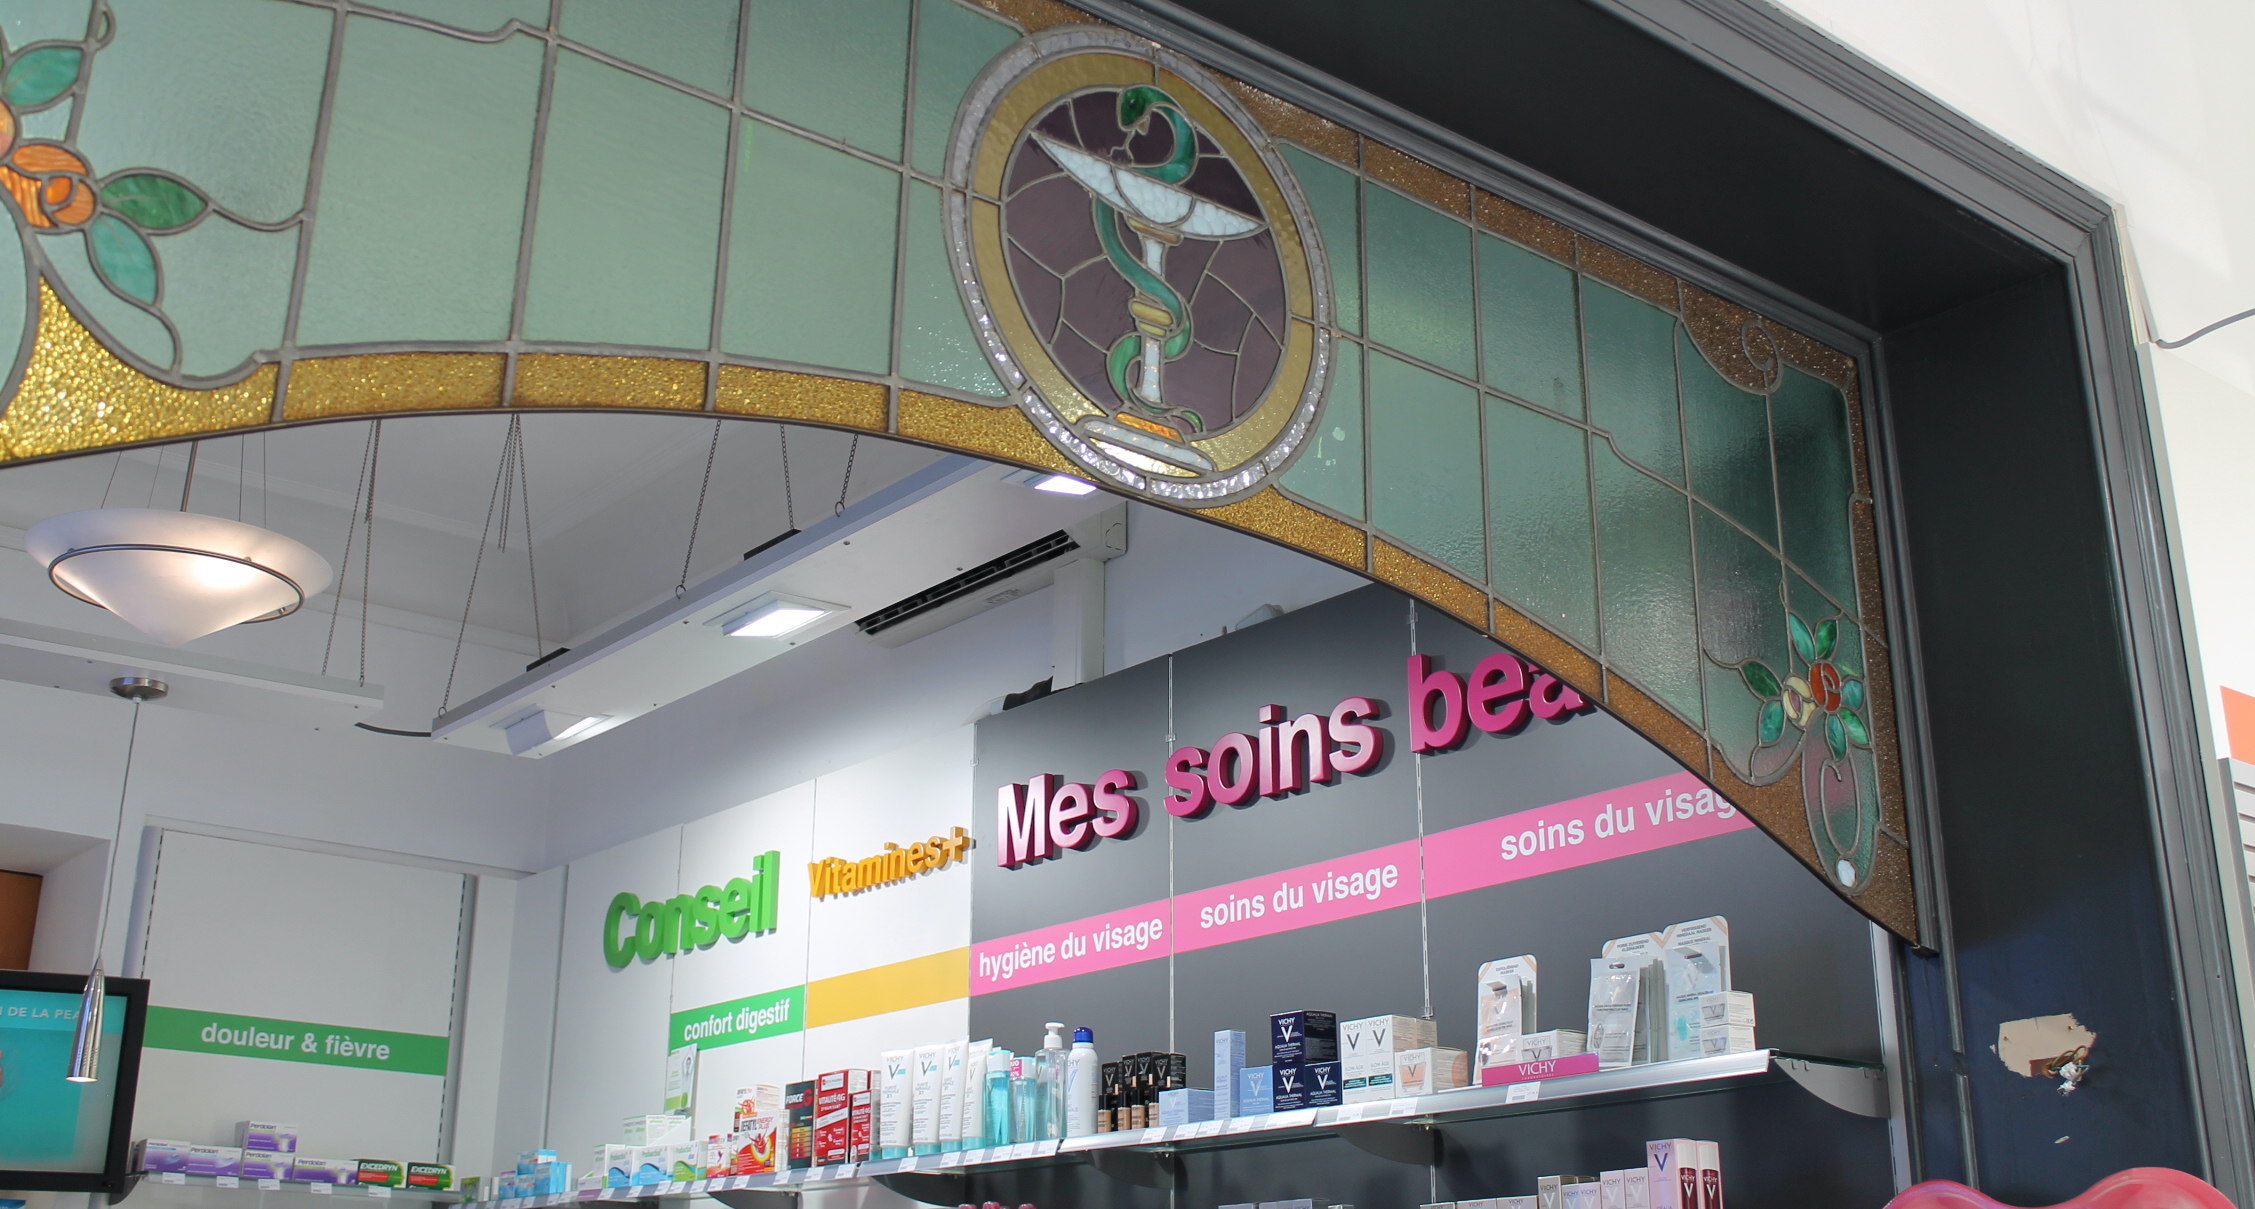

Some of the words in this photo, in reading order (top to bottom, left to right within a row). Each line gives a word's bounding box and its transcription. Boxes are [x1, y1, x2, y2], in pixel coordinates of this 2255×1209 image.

[997, 769, 1138, 867] Mes
[1163, 696, 1384, 818] soins
[1501, 818, 1586, 861] soins
[1595, 803, 1636, 839] du
[807, 826, 976, 898] Vitamines+
[1199, 893, 1266, 929] soins
[1271, 882, 1304, 912] du
[1311, 863, 1399, 904] visage
[603, 850, 780, 968] Conseil
[978, 943, 1056, 982] hygiène
[1060, 931, 1087, 961] du
[1092, 916, 1164, 953] visage
[7, 1006, 28, 1017] DE
[31, 1008, 49, 1018] LA
[683, 1011, 733, 1041] confort
[735, 998, 791, 1034] digestif
[1278, 1017, 1296, 1025] VICHY
[1343, 1022, 1364, 1031] VICHY
[1368, 1018, 1389, 1027] VICHY
[201, 1022, 295, 1050] douleur
[301, 1032, 318, 1053] &
[325, 1034, 391, 1060] fièvre
[1281, 1025, 1293, 1042] V
[1372, 1028, 1386, 1047] V
[1346, 1032, 1360, 1051] V
[918, 1051, 936, 1059] VICHY
[1403, 1053, 1421, 1062] VICHY
[921, 1060, 932, 1076] V
[948, 1055, 957, 1071] V
[1139, 1063, 1149, 1075] V
[1314, 1066, 1331, 1074] VICHY
[1517, 1060, 1557, 1076] VICHY
[888, 1063, 900, 1080] V
[969, 1068, 976, 1082] V
[1125, 1065, 1133, 1077] V
[1157, 1066, 1166, 1080] V
[1280, 1067, 1297, 1075] VICHY
[1408, 1064, 1417, 1078] V
[1105, 1074, 1114, 1087] V
[1250, 1079, 1263, 1096] V
[1282, 1075, 1295, 1093] V
[1317, 1074, 1328, 1090] V
[785, 1093, 804, 1104] FORCE
[803, 1088, 814, 1106] G
[1169, 1097, 1177, 1108] V
[250, 1122, 277, 1130] Perdolan
[1649, 1142, 1672, 1151] VICHY
[297, 1158, 327, 1166] Perdolan
[359, 1162, 399, 1172] EXCEDRYN
[1654, 1152, 1668, 1172] V
[410, 1165, 448, 1175] EXCEDRYN
[1602, 1178, 1621, 1186] VICHY
[1703, 1175, 1717, 1183] VICHY
[1540, 1183, 1558, 1191] VICHY
[1630, 1184, 1643, 1201] V
[1683, 1183, 1694, 1198] V
[1706, 1184, 1716, 1199] V
[1543, 1192, 1556, 1209] V
[1606, 1187, 1619, 1204] V
